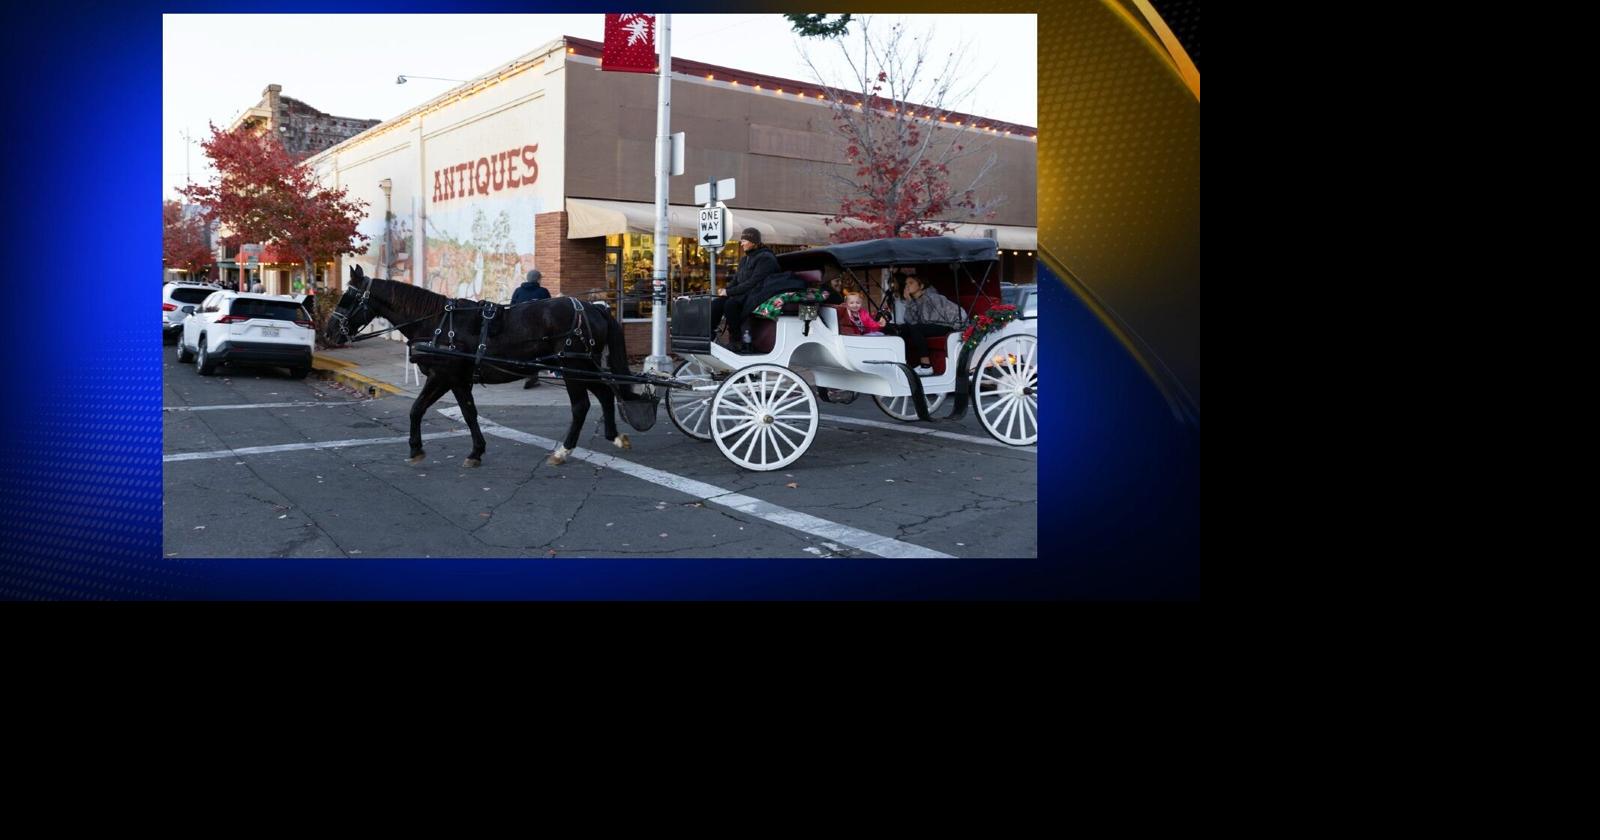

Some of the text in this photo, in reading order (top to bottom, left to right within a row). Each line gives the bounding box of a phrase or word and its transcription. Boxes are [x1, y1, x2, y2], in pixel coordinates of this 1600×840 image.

[432, 143, 539, 203] ANTIQUES
[701, 210, 719, 221] ONE
[701, 221, 719, 231] WAY
